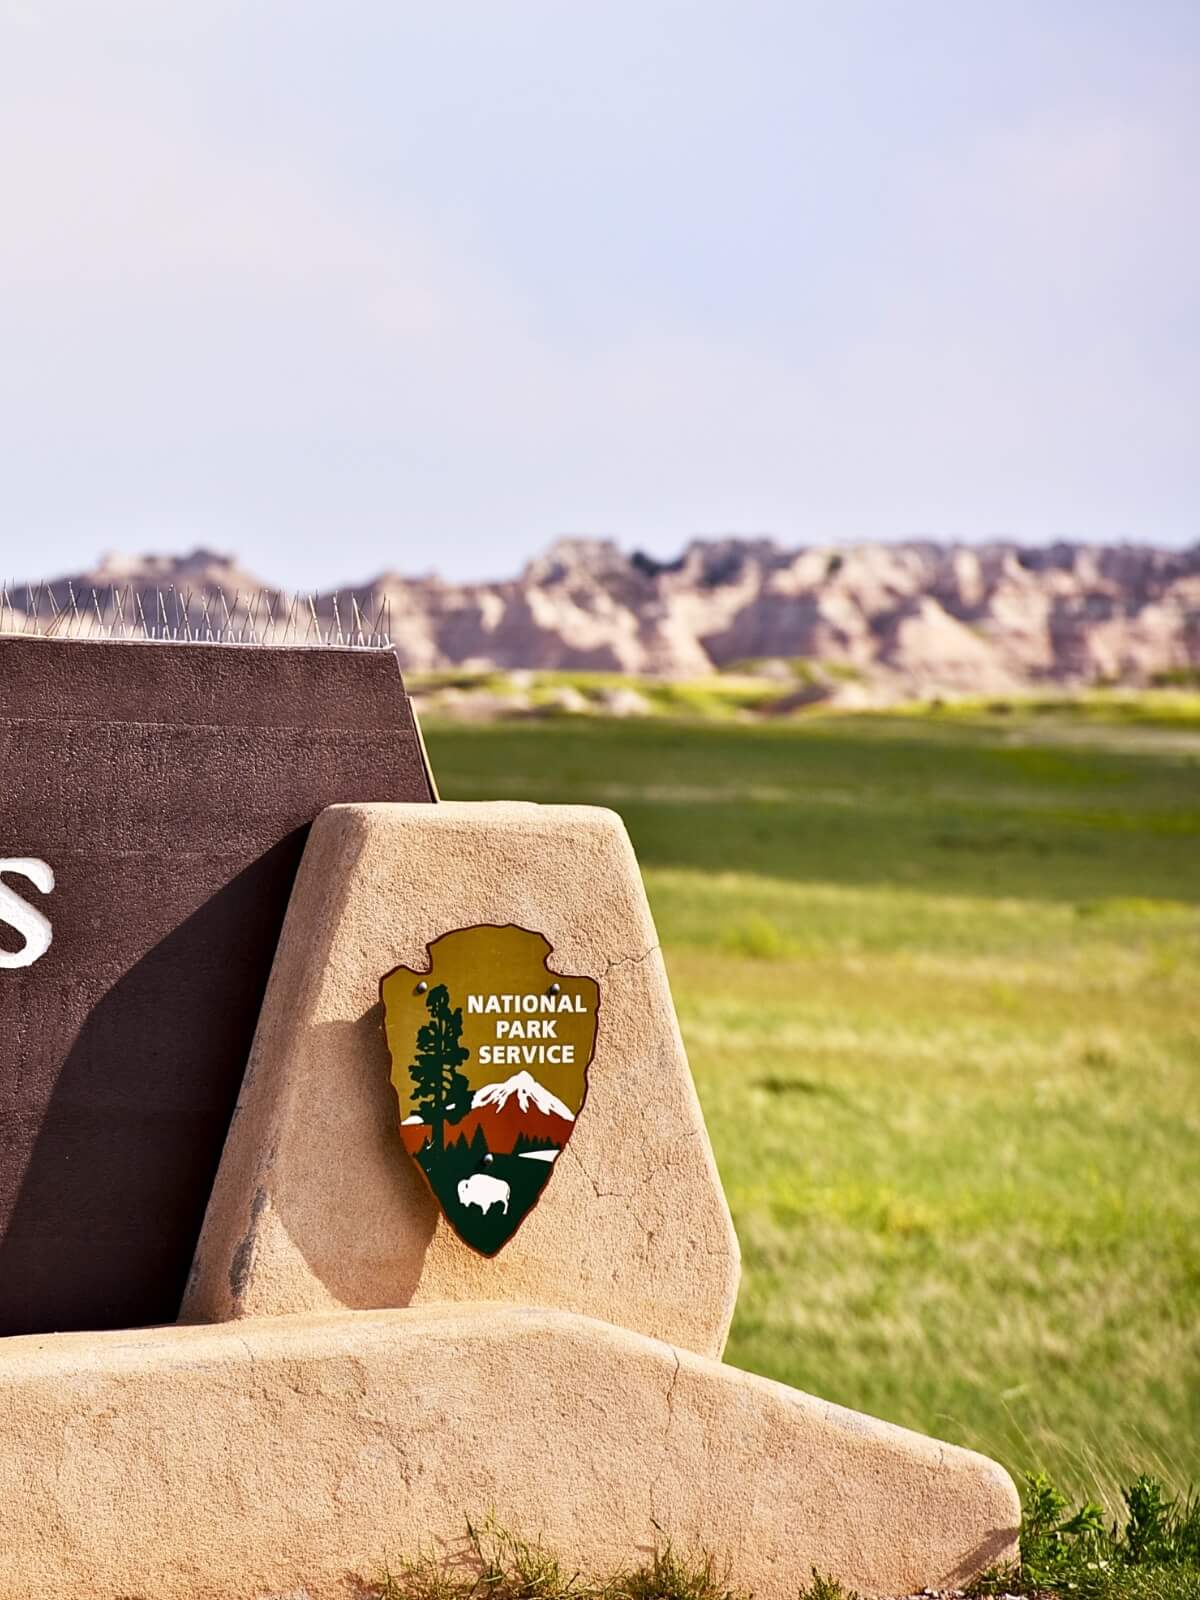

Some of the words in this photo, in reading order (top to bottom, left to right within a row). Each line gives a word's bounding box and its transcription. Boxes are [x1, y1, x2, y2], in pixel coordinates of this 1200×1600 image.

[467, 994, 588, 1014] NATIONAL
[495, 1020, 558, 1039] PARK
[479, 1045, 575, 1064] SERVICE
